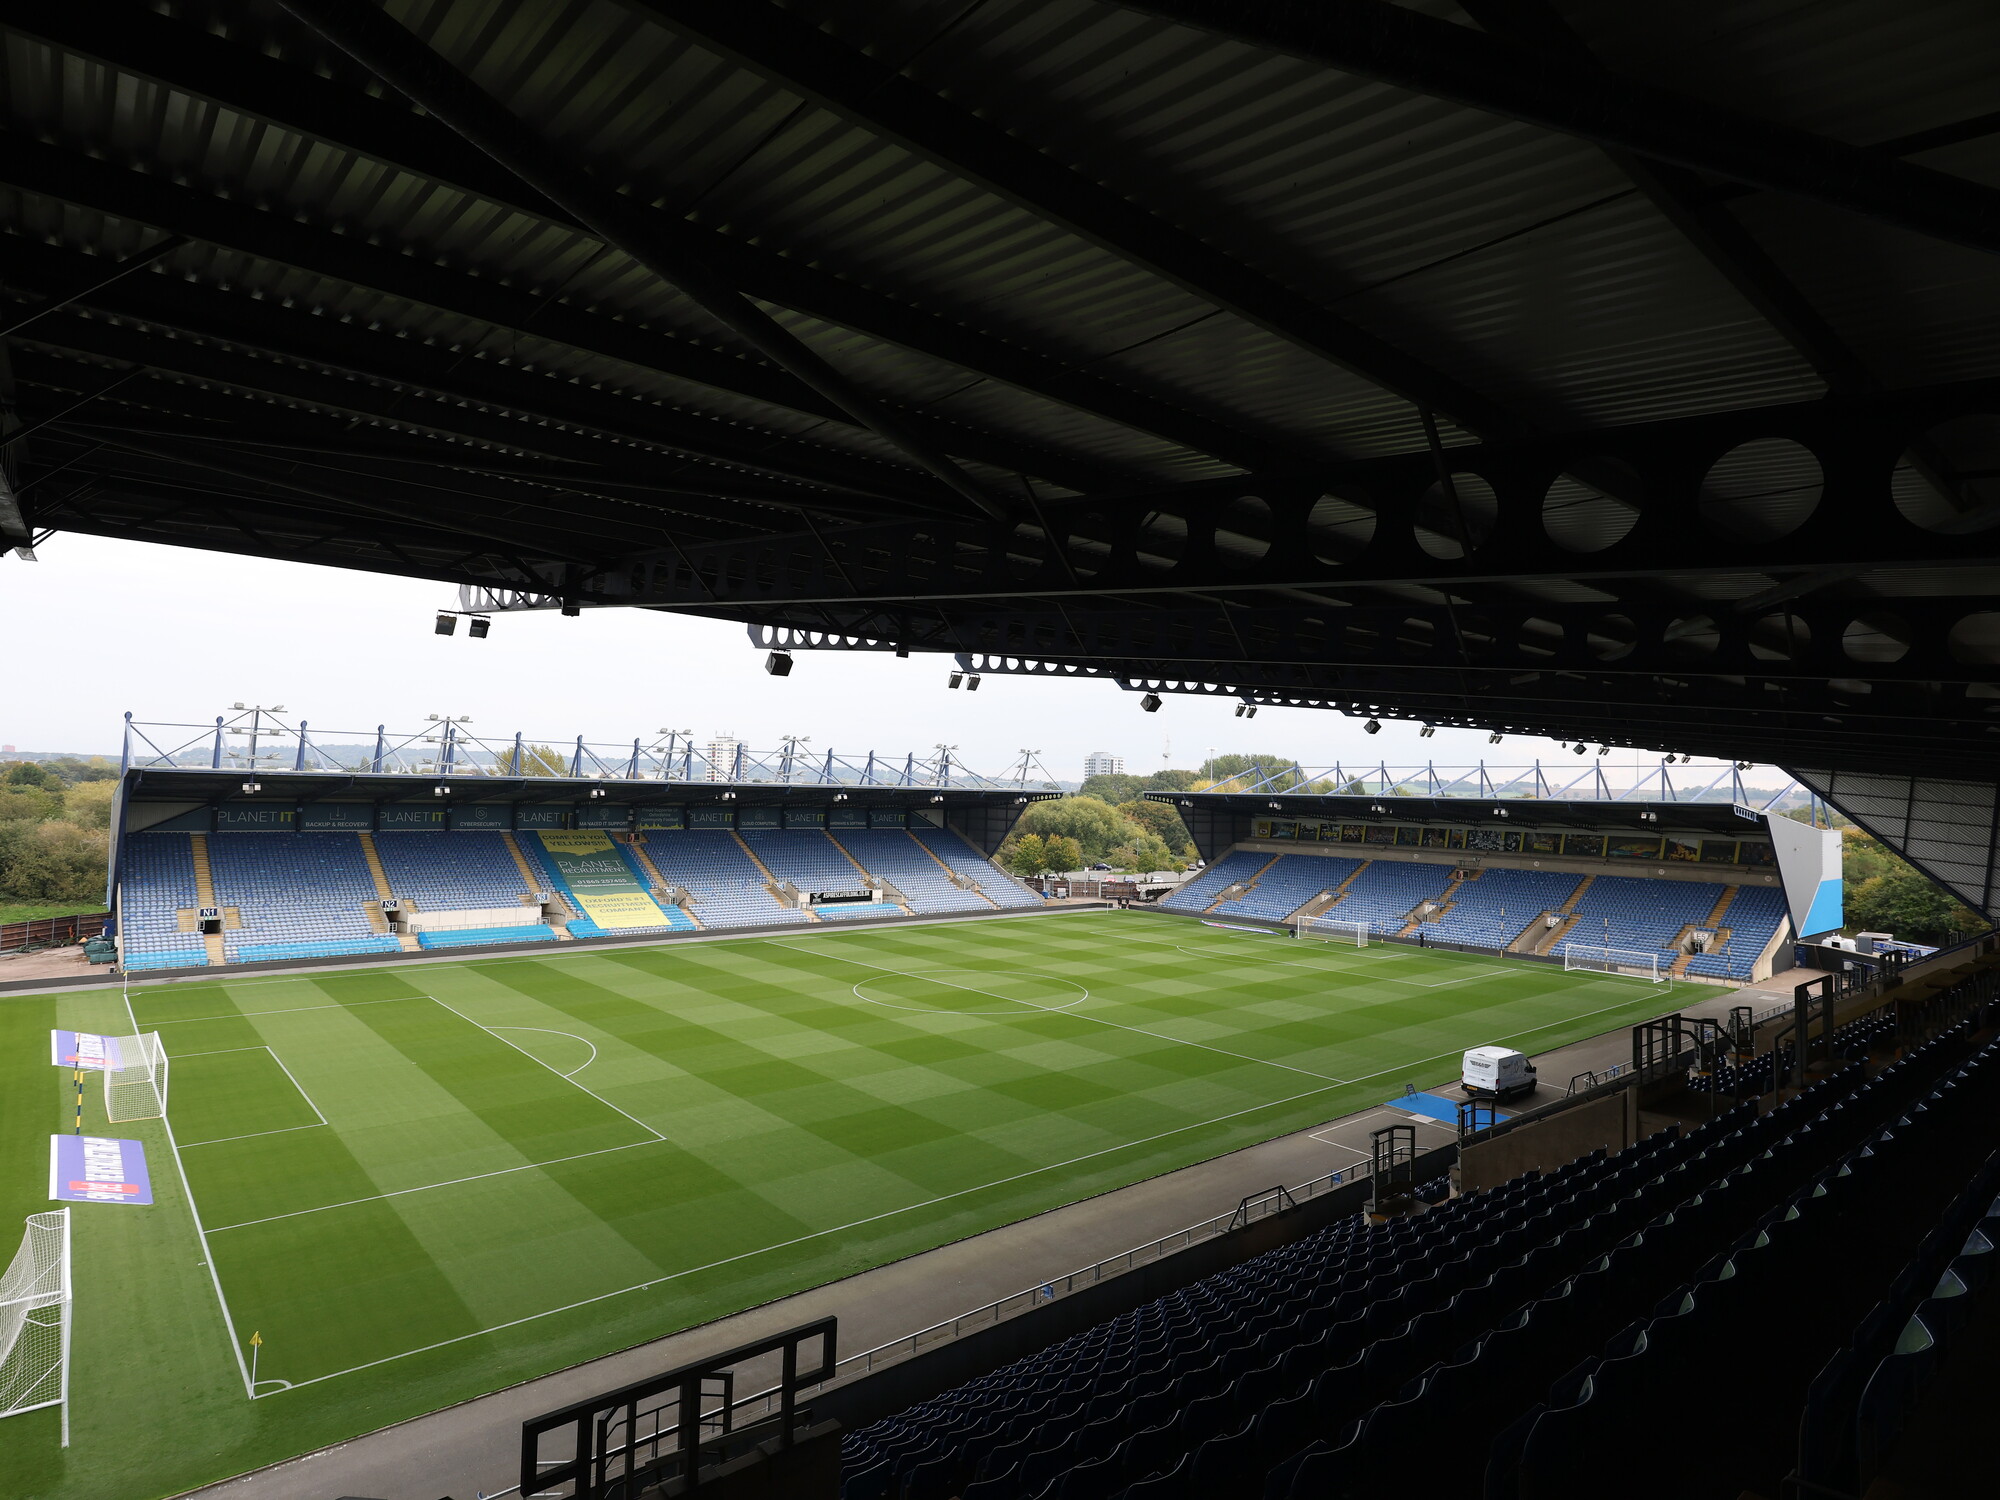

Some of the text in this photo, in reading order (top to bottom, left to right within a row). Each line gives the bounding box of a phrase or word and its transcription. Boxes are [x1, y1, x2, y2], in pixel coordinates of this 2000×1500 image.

[217, 810, 296, 823] PLANET IT
[379, 811, 445, 823] PLANET IT
[517, 812, 561, 823] PLANET
[689, 813, 735, 823] PLANET IT
[785, 813, 826, 823] PLANET IT
[871, 814, 907, 823] PLANET IT
[557, 860, 621, 868] PLANET
[561, 866, 626, 874] RECRUITMENT
[385, 900, 396, 908] N2
[586, 901, 652, 909] RECRUITMENT
[203, 908, 215, 917] N1
